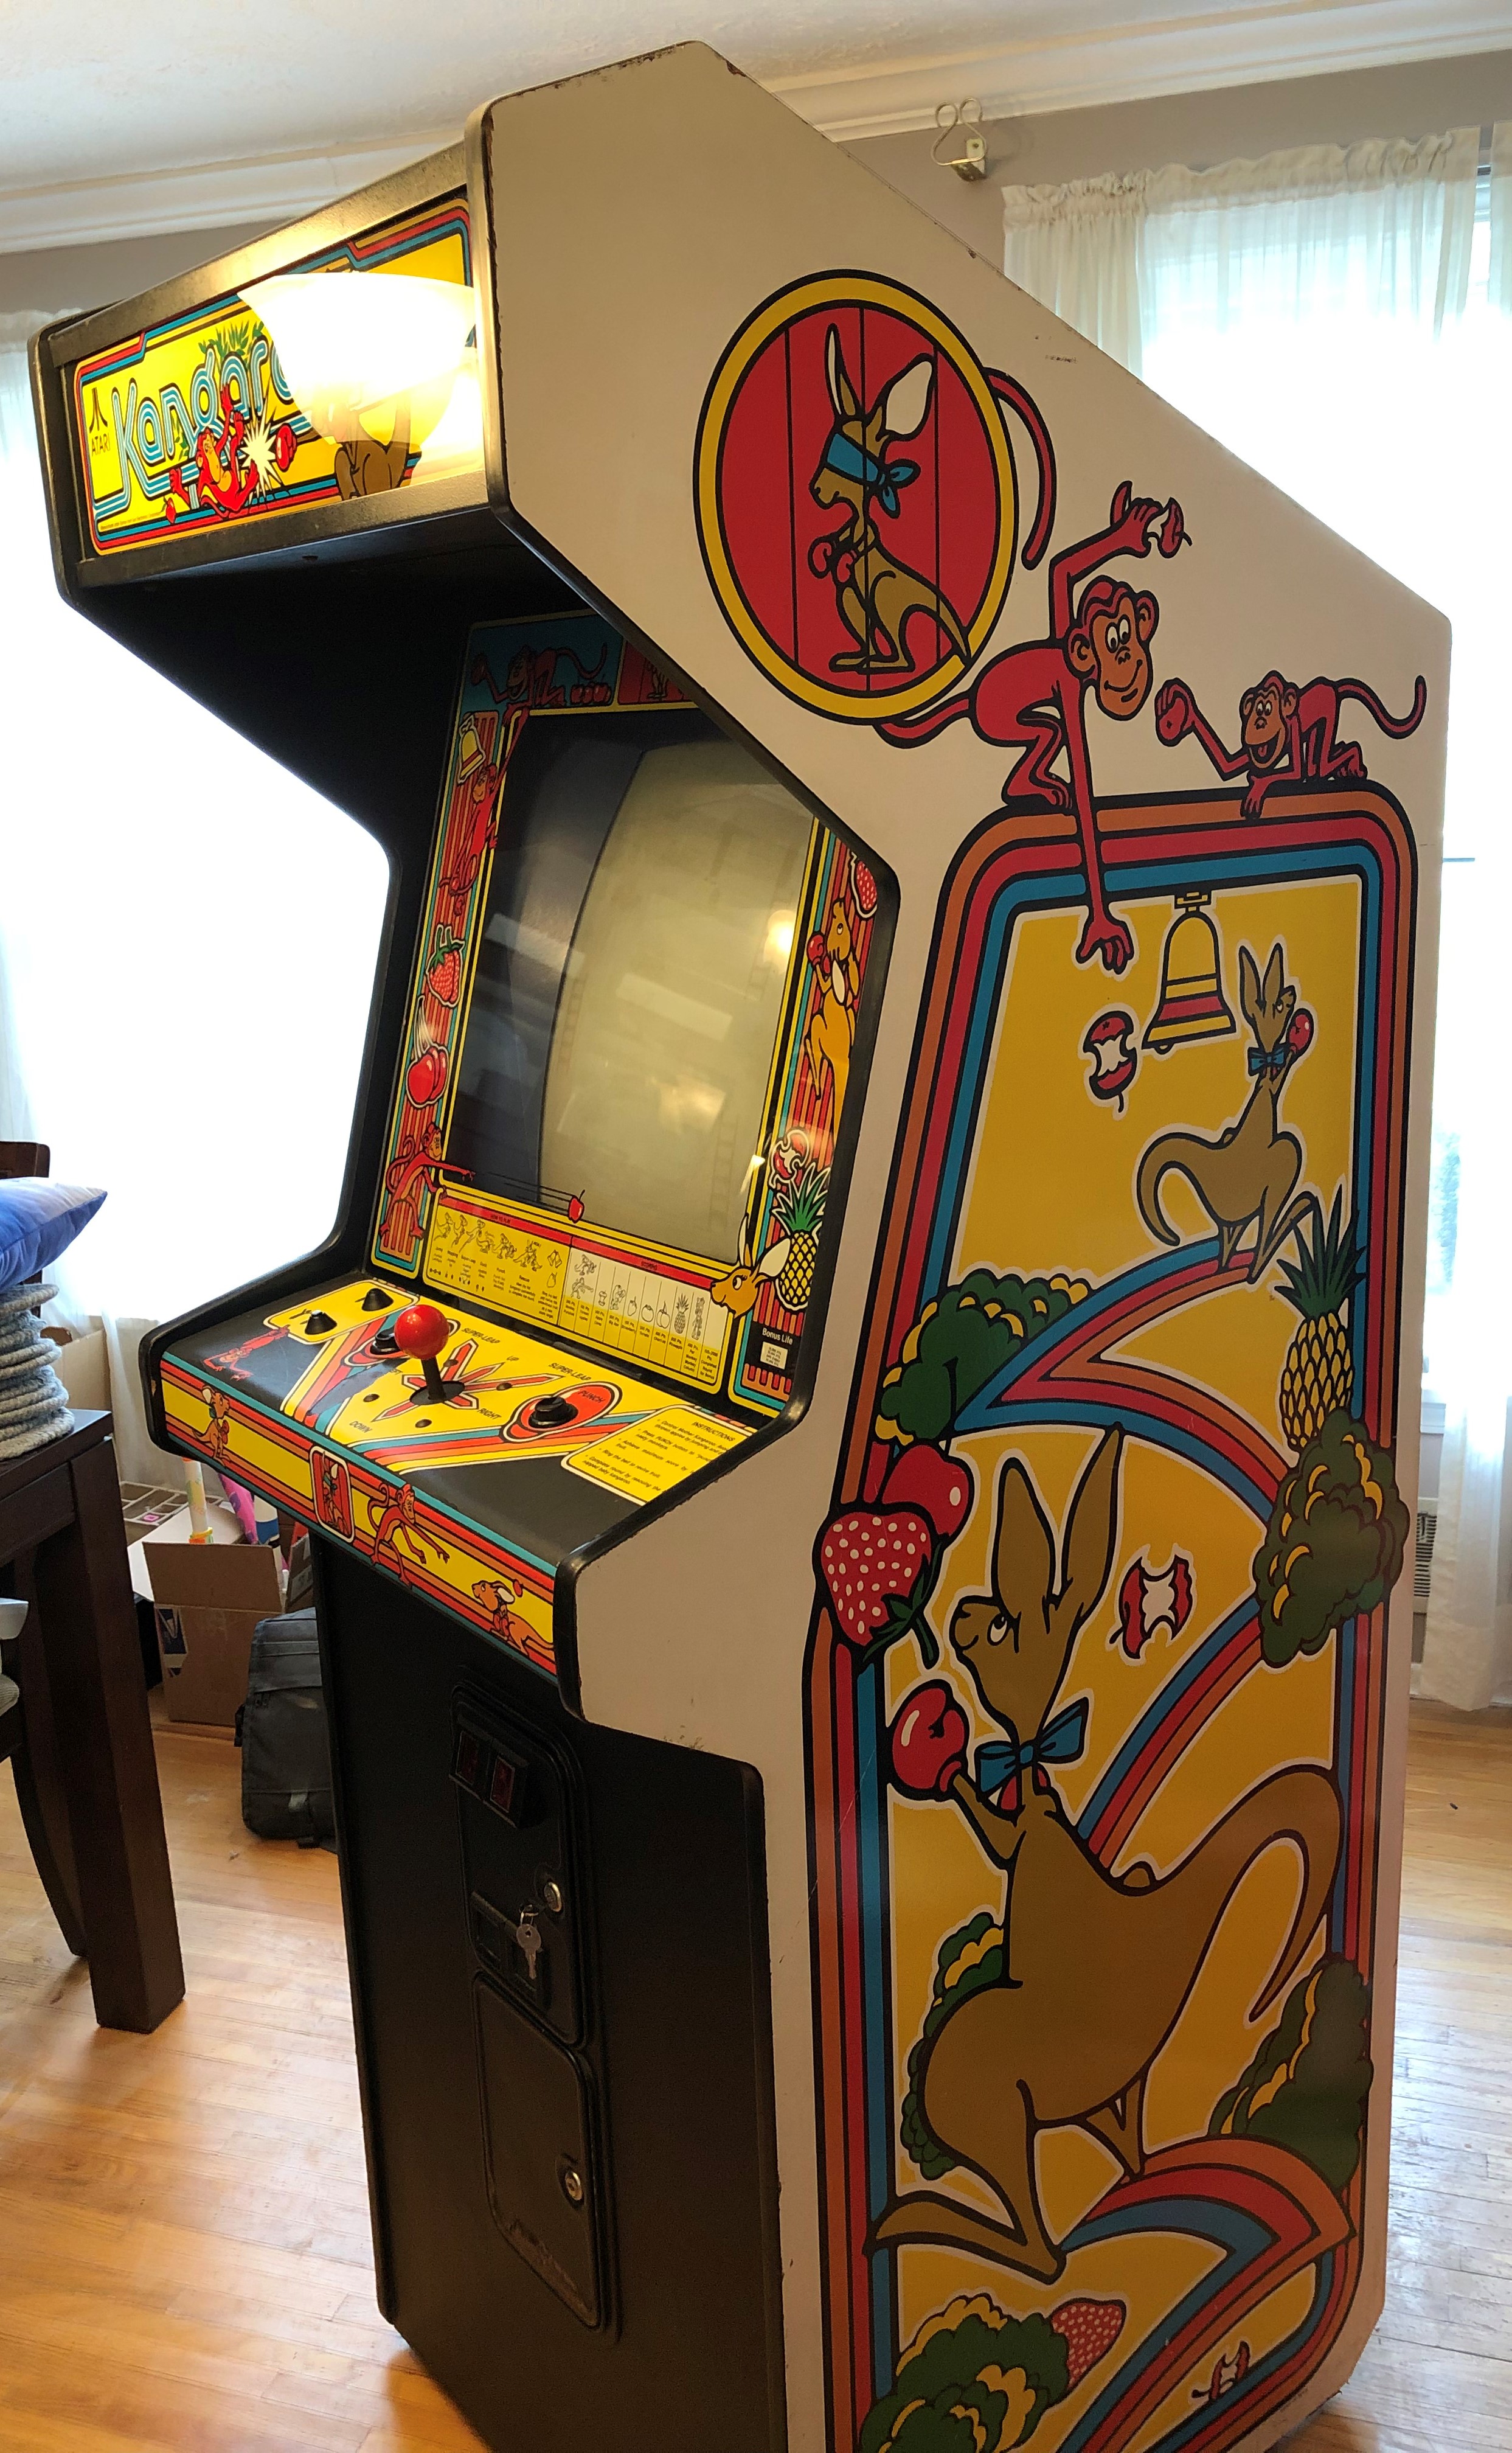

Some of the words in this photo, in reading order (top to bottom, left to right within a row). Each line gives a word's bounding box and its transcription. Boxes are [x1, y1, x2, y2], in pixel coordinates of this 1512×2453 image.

[111, 333, 296, 512] Kangaro
[91, 433, 111, 457] ATARI
[462, 1327, 500, 1344] SUPER-LEAP
[762, 1327, 781, 1340] Bonus
[782, 1334, 793, 1345] Life
[549, 1363, 591, 1381] SUPER-LEAP
[578, 1390, 604, 1404] PUNCH
[477, 1408, 502, 1420] RIGHT
[349, 1421, 372, 1433] DOWN
[691, 1421, 735, 1442] INSTRUCTIONS
